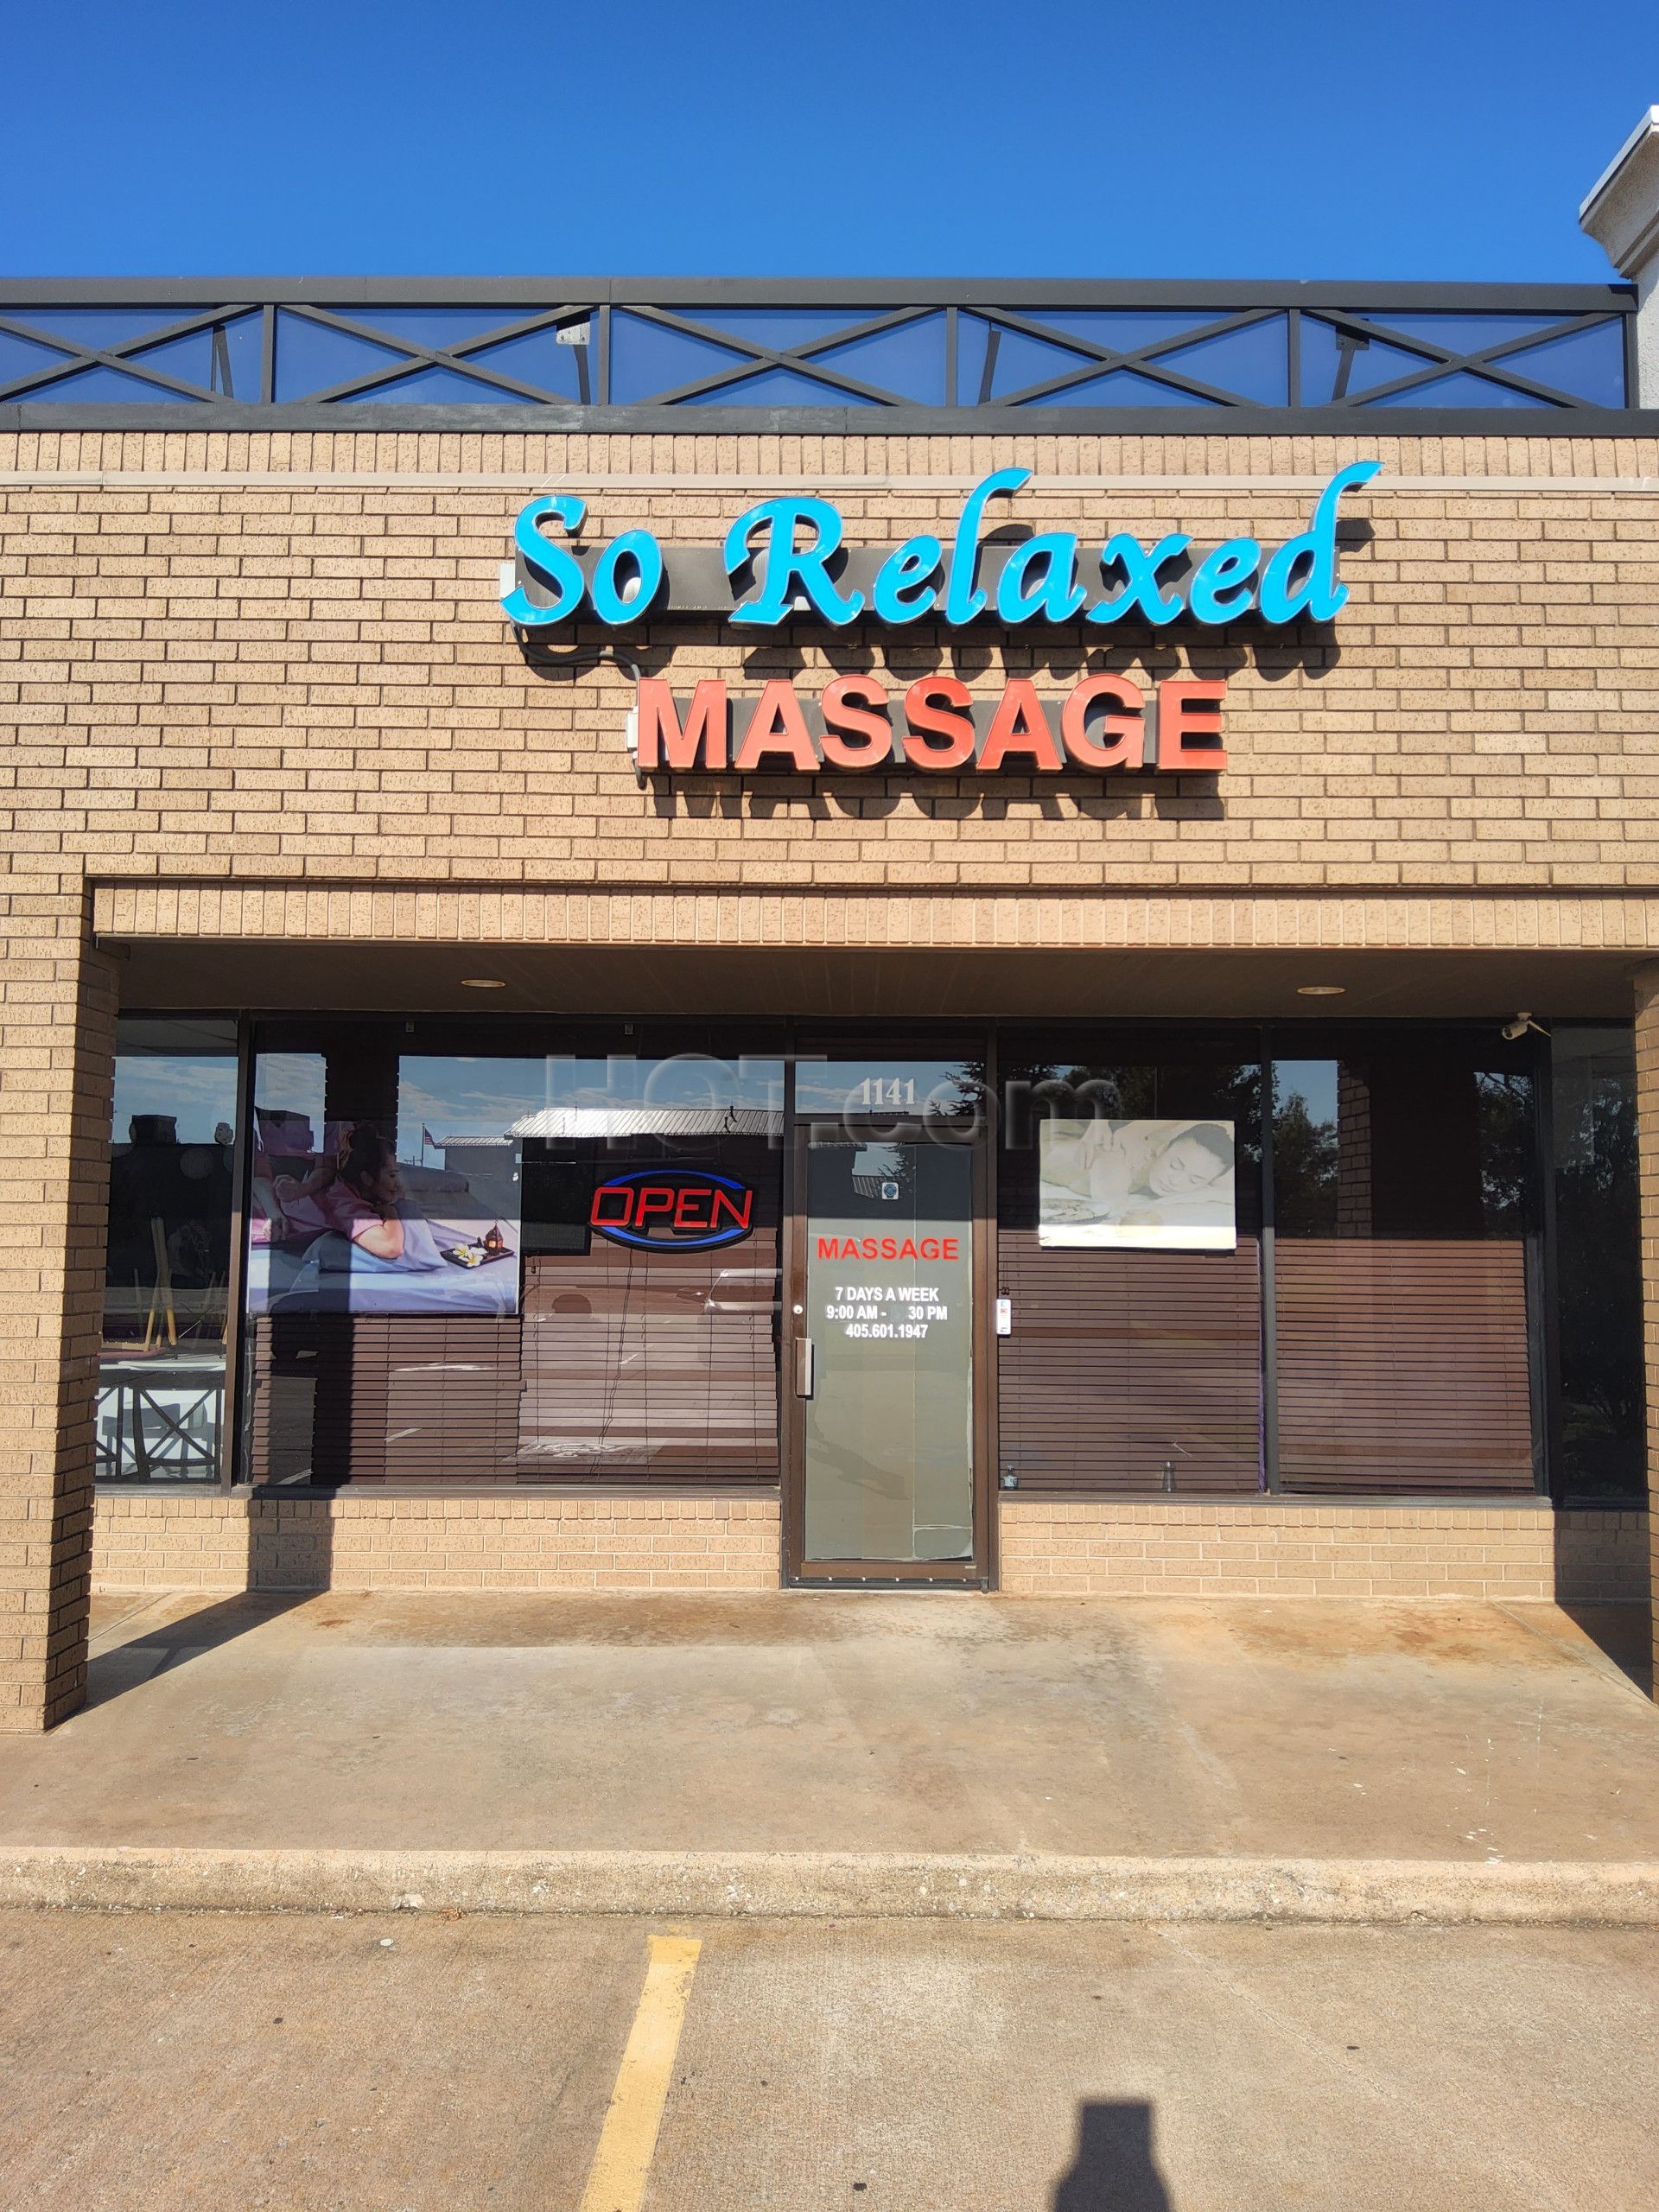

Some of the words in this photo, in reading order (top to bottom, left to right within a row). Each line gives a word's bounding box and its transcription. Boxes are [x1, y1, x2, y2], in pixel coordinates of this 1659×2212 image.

[500, 493, 663, 626] So
[724, 461, 1382, 626] Relaxed
[637, 673, 1227, 772] MASSAGE
[861, 1078, 916, 1106] 1141
[590, 1185, 753, 1230] OPEN
[817, 1237, 959, 1260] MASSAGE
[835, 1287, 843, 1301] 7
[847, 1287, 883, 1301] DAYS
[885, 1287, 896, 1301] A
[898, 1287, 939, 1302] WEEK
[826, 1305, 854, 1319] 9:00
[856, 1305, 878, 1319] AM
[927, 1306, 948, 1319] PM
[845, 1324, 929, 1338] 405.601.1947
